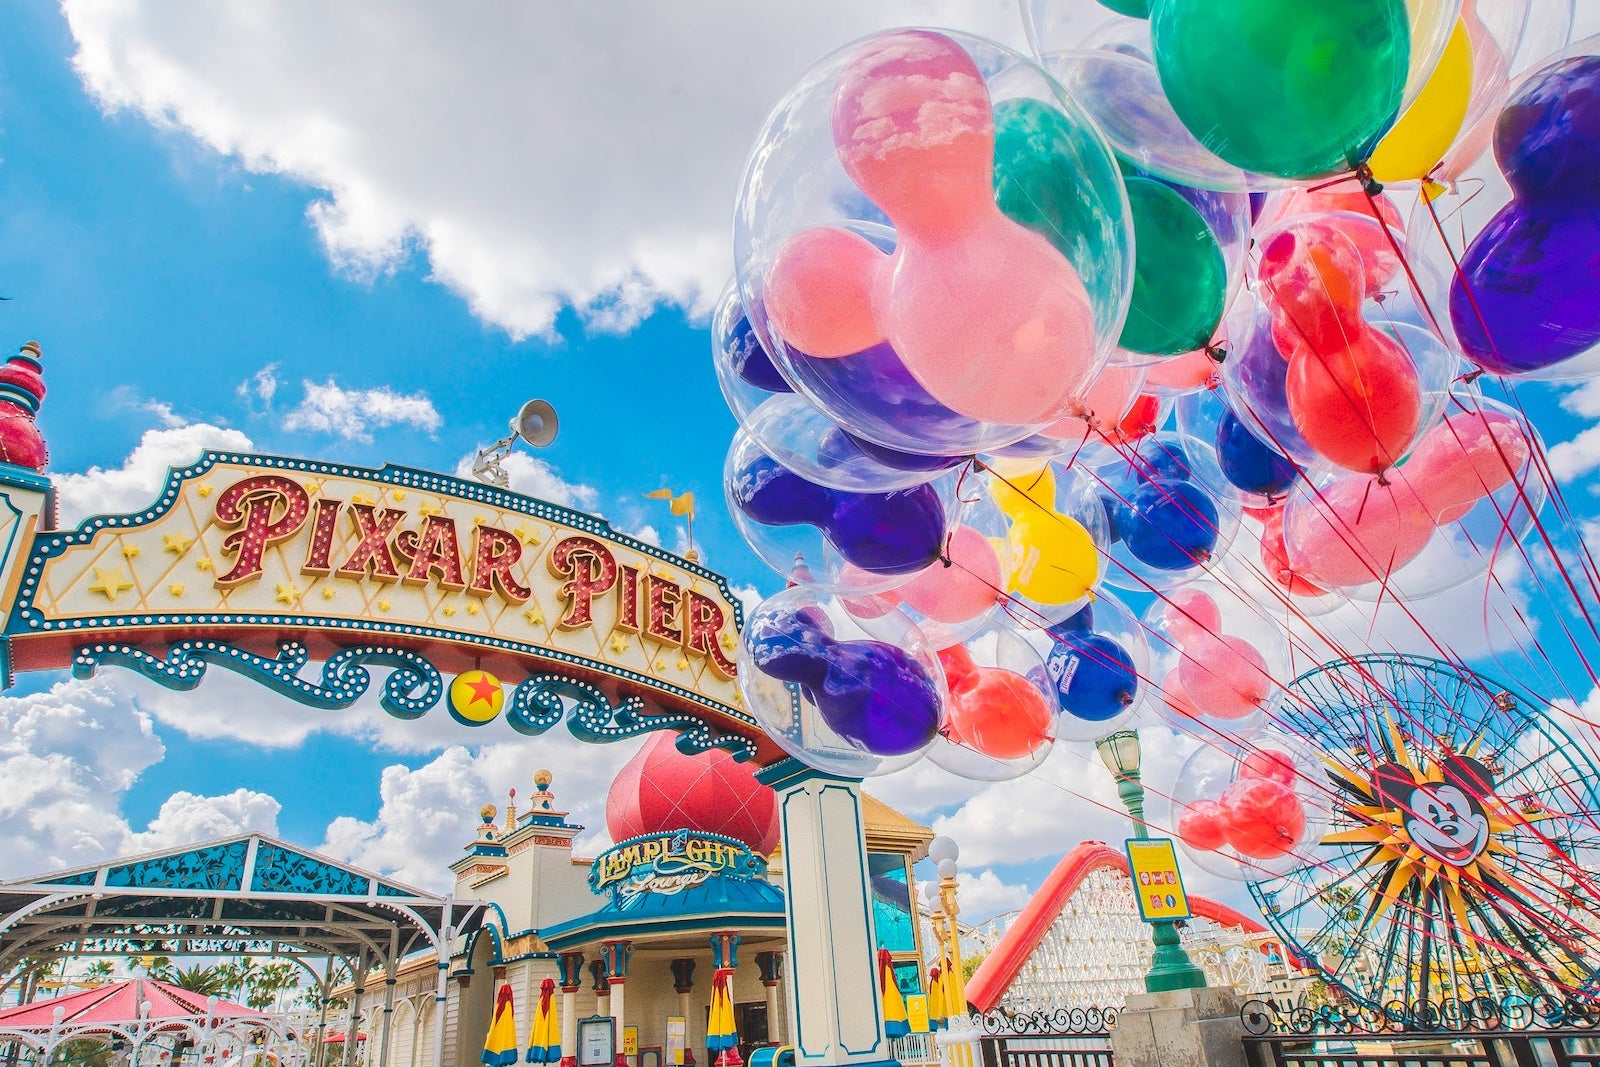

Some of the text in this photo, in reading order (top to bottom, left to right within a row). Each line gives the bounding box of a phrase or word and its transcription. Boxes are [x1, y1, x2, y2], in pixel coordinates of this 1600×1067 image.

[213, 475, 738, 681] PIXAR PIER
[620, 870, 712, 896] Lounge
